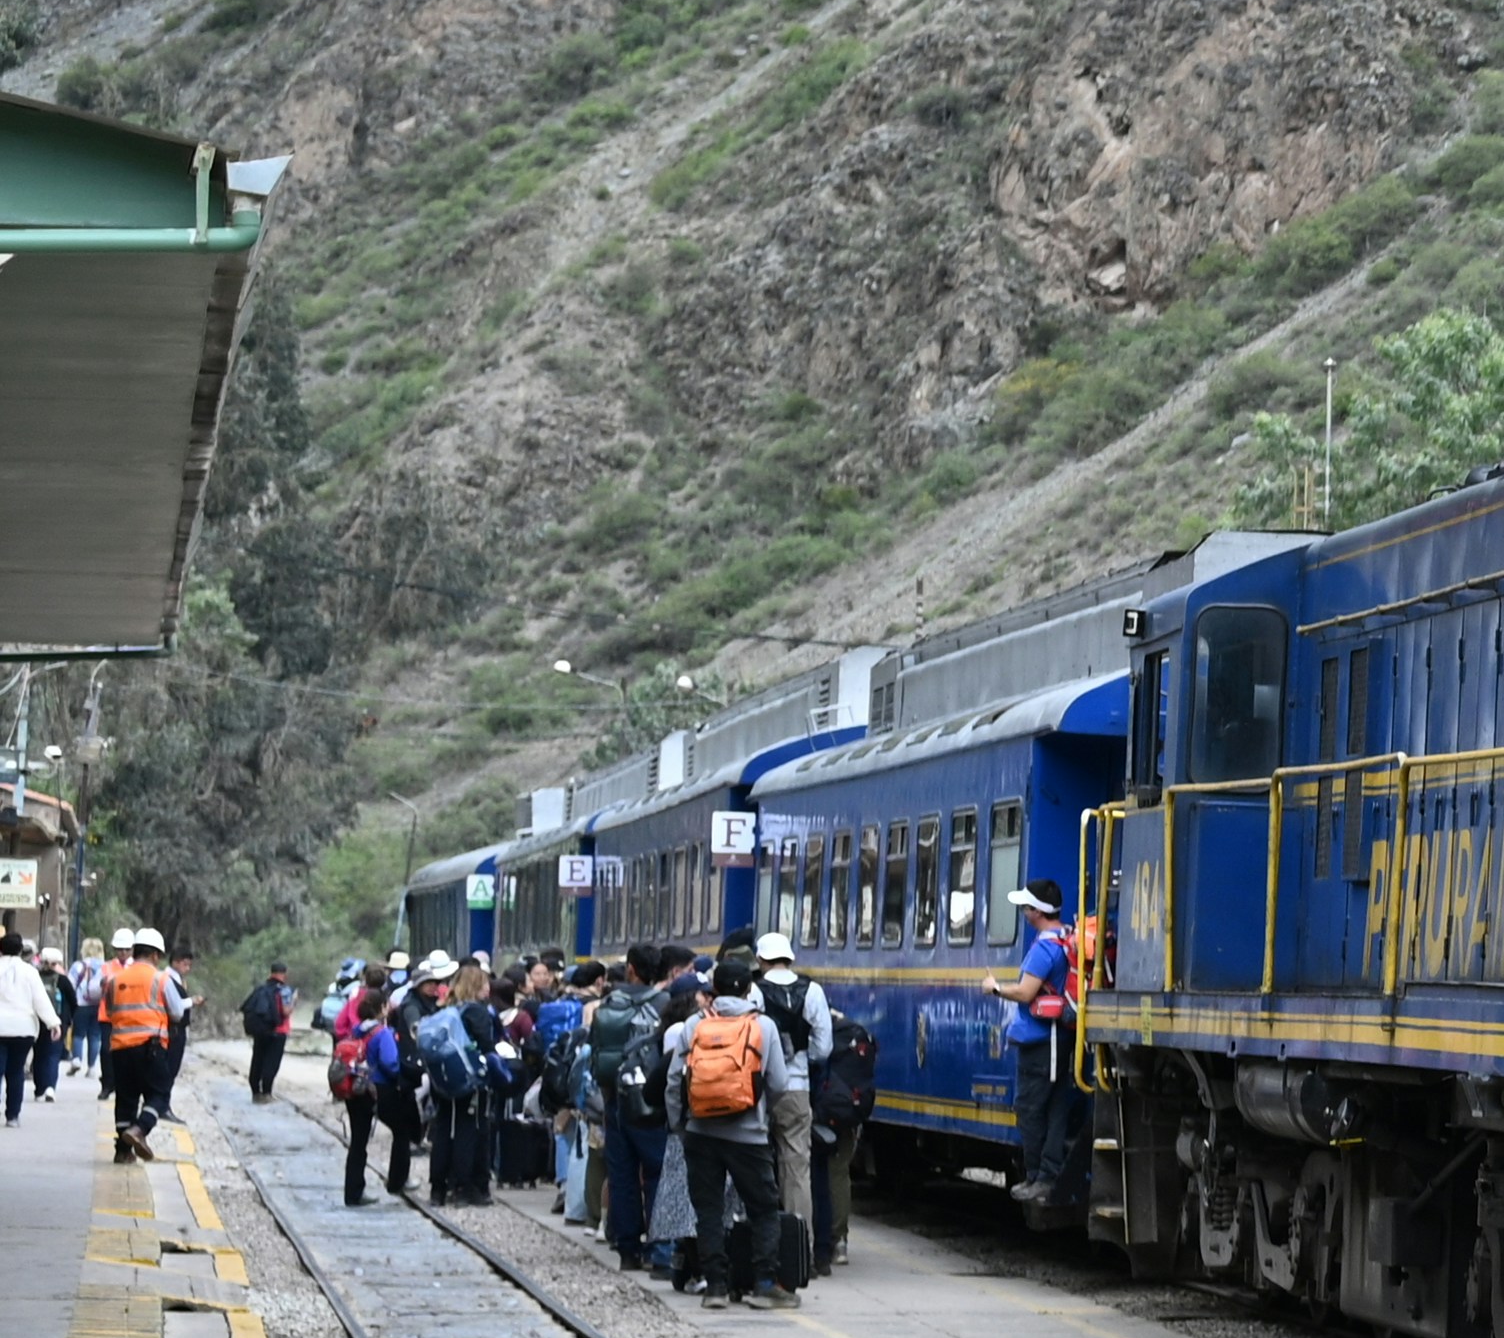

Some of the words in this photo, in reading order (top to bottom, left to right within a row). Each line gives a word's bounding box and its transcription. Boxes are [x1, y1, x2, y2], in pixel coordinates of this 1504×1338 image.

[722, 818, 747, 848] F
[567, 860, 587, 882] E
[473, 879, 490, 896] A
[1131, 859, 1160, 942] 484
